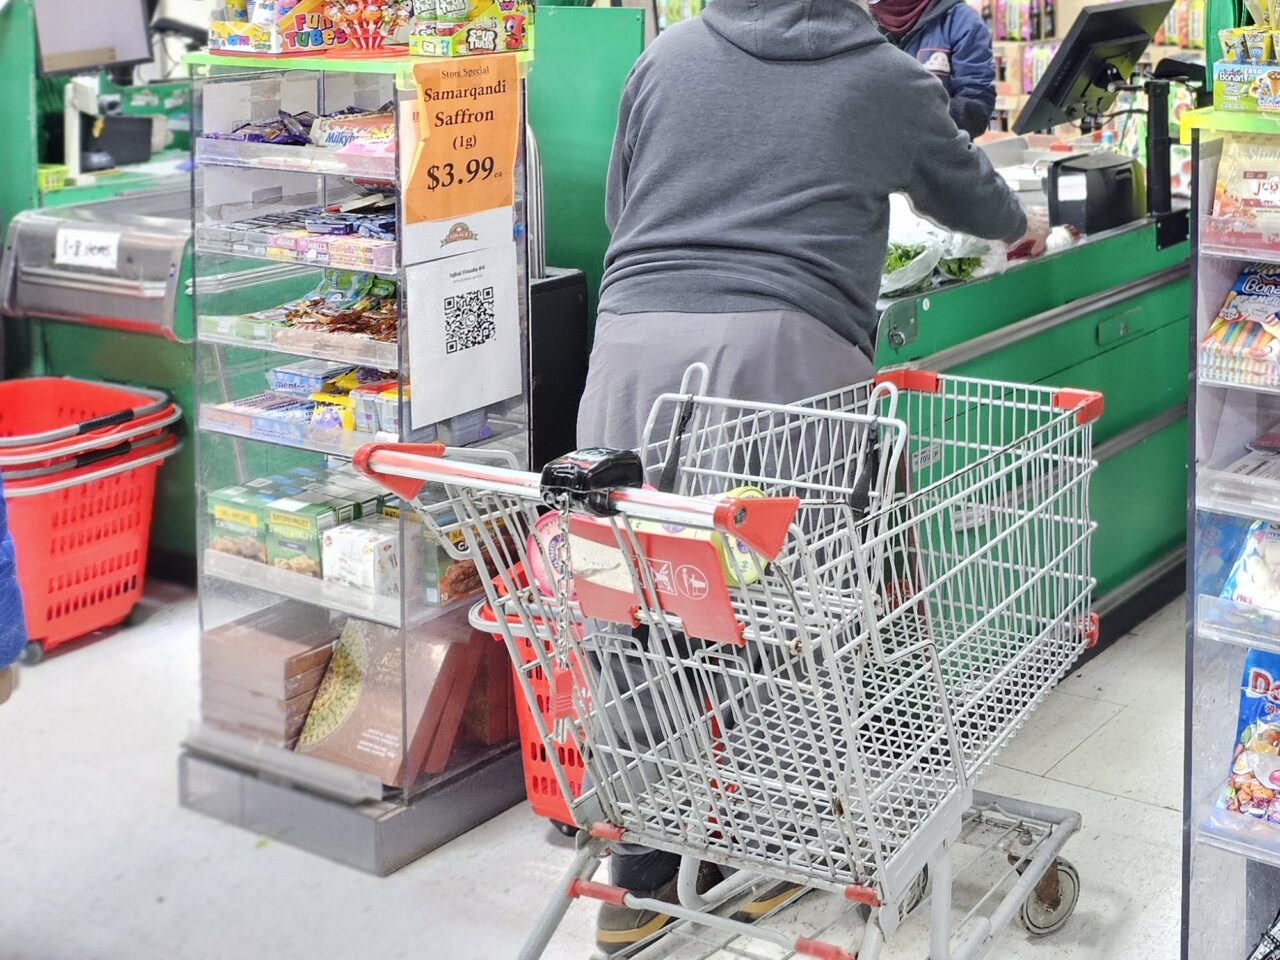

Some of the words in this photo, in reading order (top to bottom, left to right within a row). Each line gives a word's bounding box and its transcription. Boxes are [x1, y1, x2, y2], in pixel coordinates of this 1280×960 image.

[442, 70, 461, 79] Store
[463, 66, 490, 78] Special
[424, 80, 506, 102] Samarqandi
[435, 109, 494, 127] Saffron
[453, 135, 477, 150] (1g)
[427, 156, 494, 191] $3.99
[441, 593, 448, 601] 10
